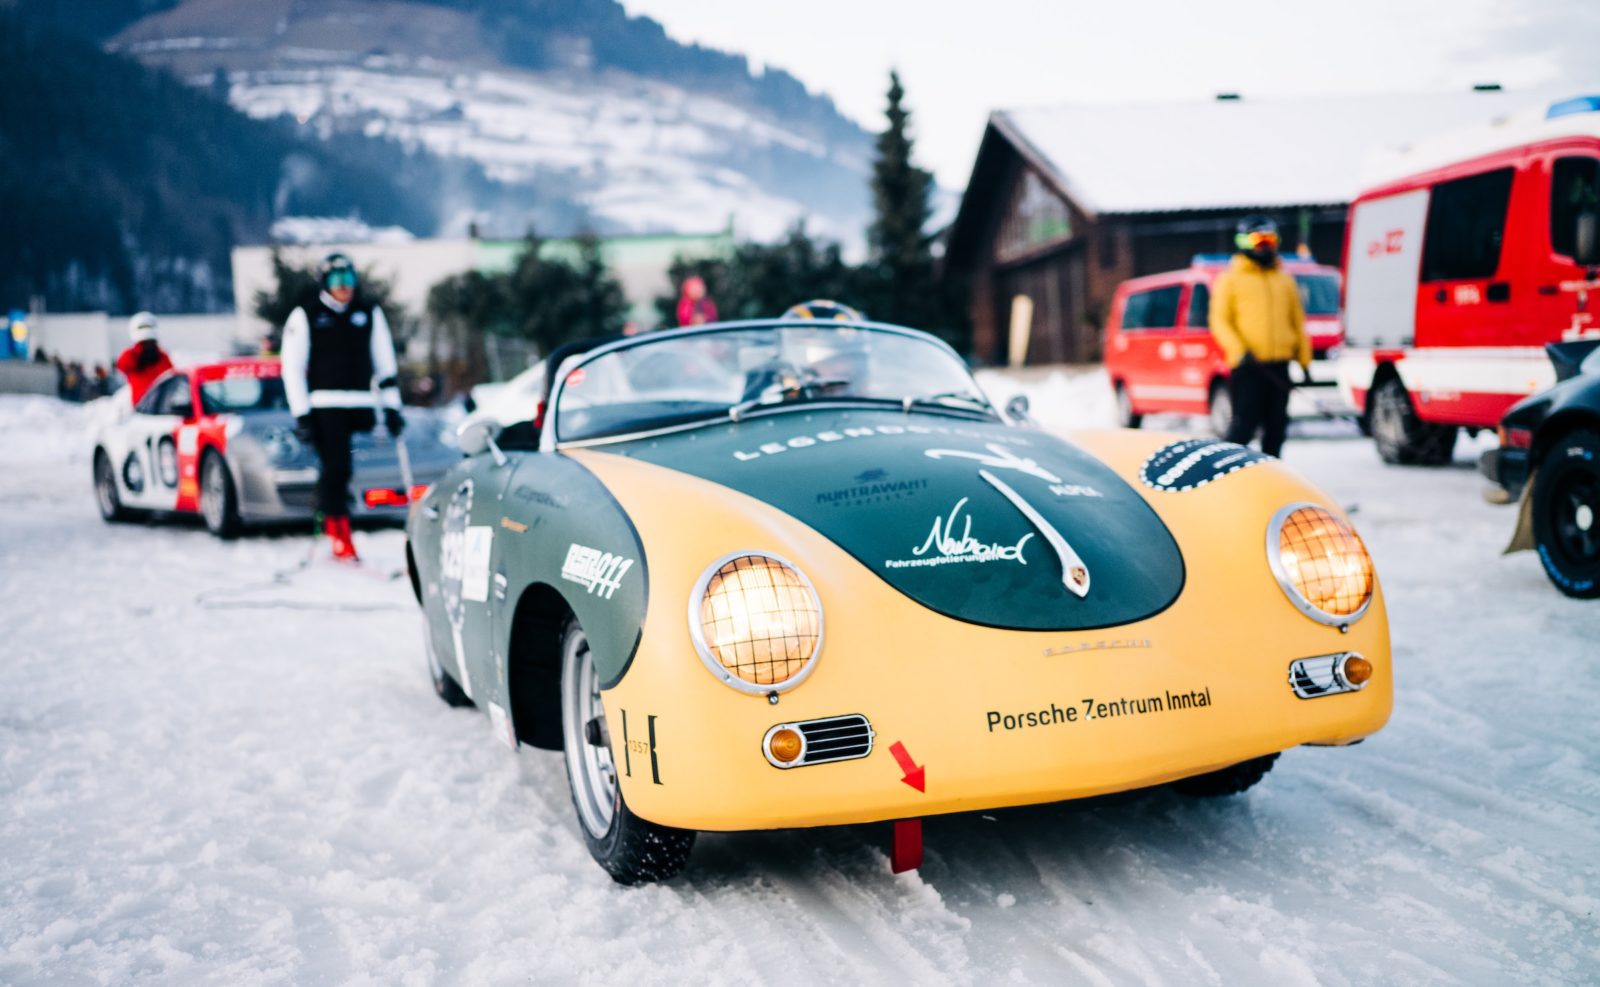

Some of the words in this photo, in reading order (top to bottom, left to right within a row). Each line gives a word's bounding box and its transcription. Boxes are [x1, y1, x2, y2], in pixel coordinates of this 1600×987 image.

[986, 704, 1078, 732] Porsche
[1081, 697, 1164, 720] Zentrum
[1166, 687, 1212, 710] Inntal
